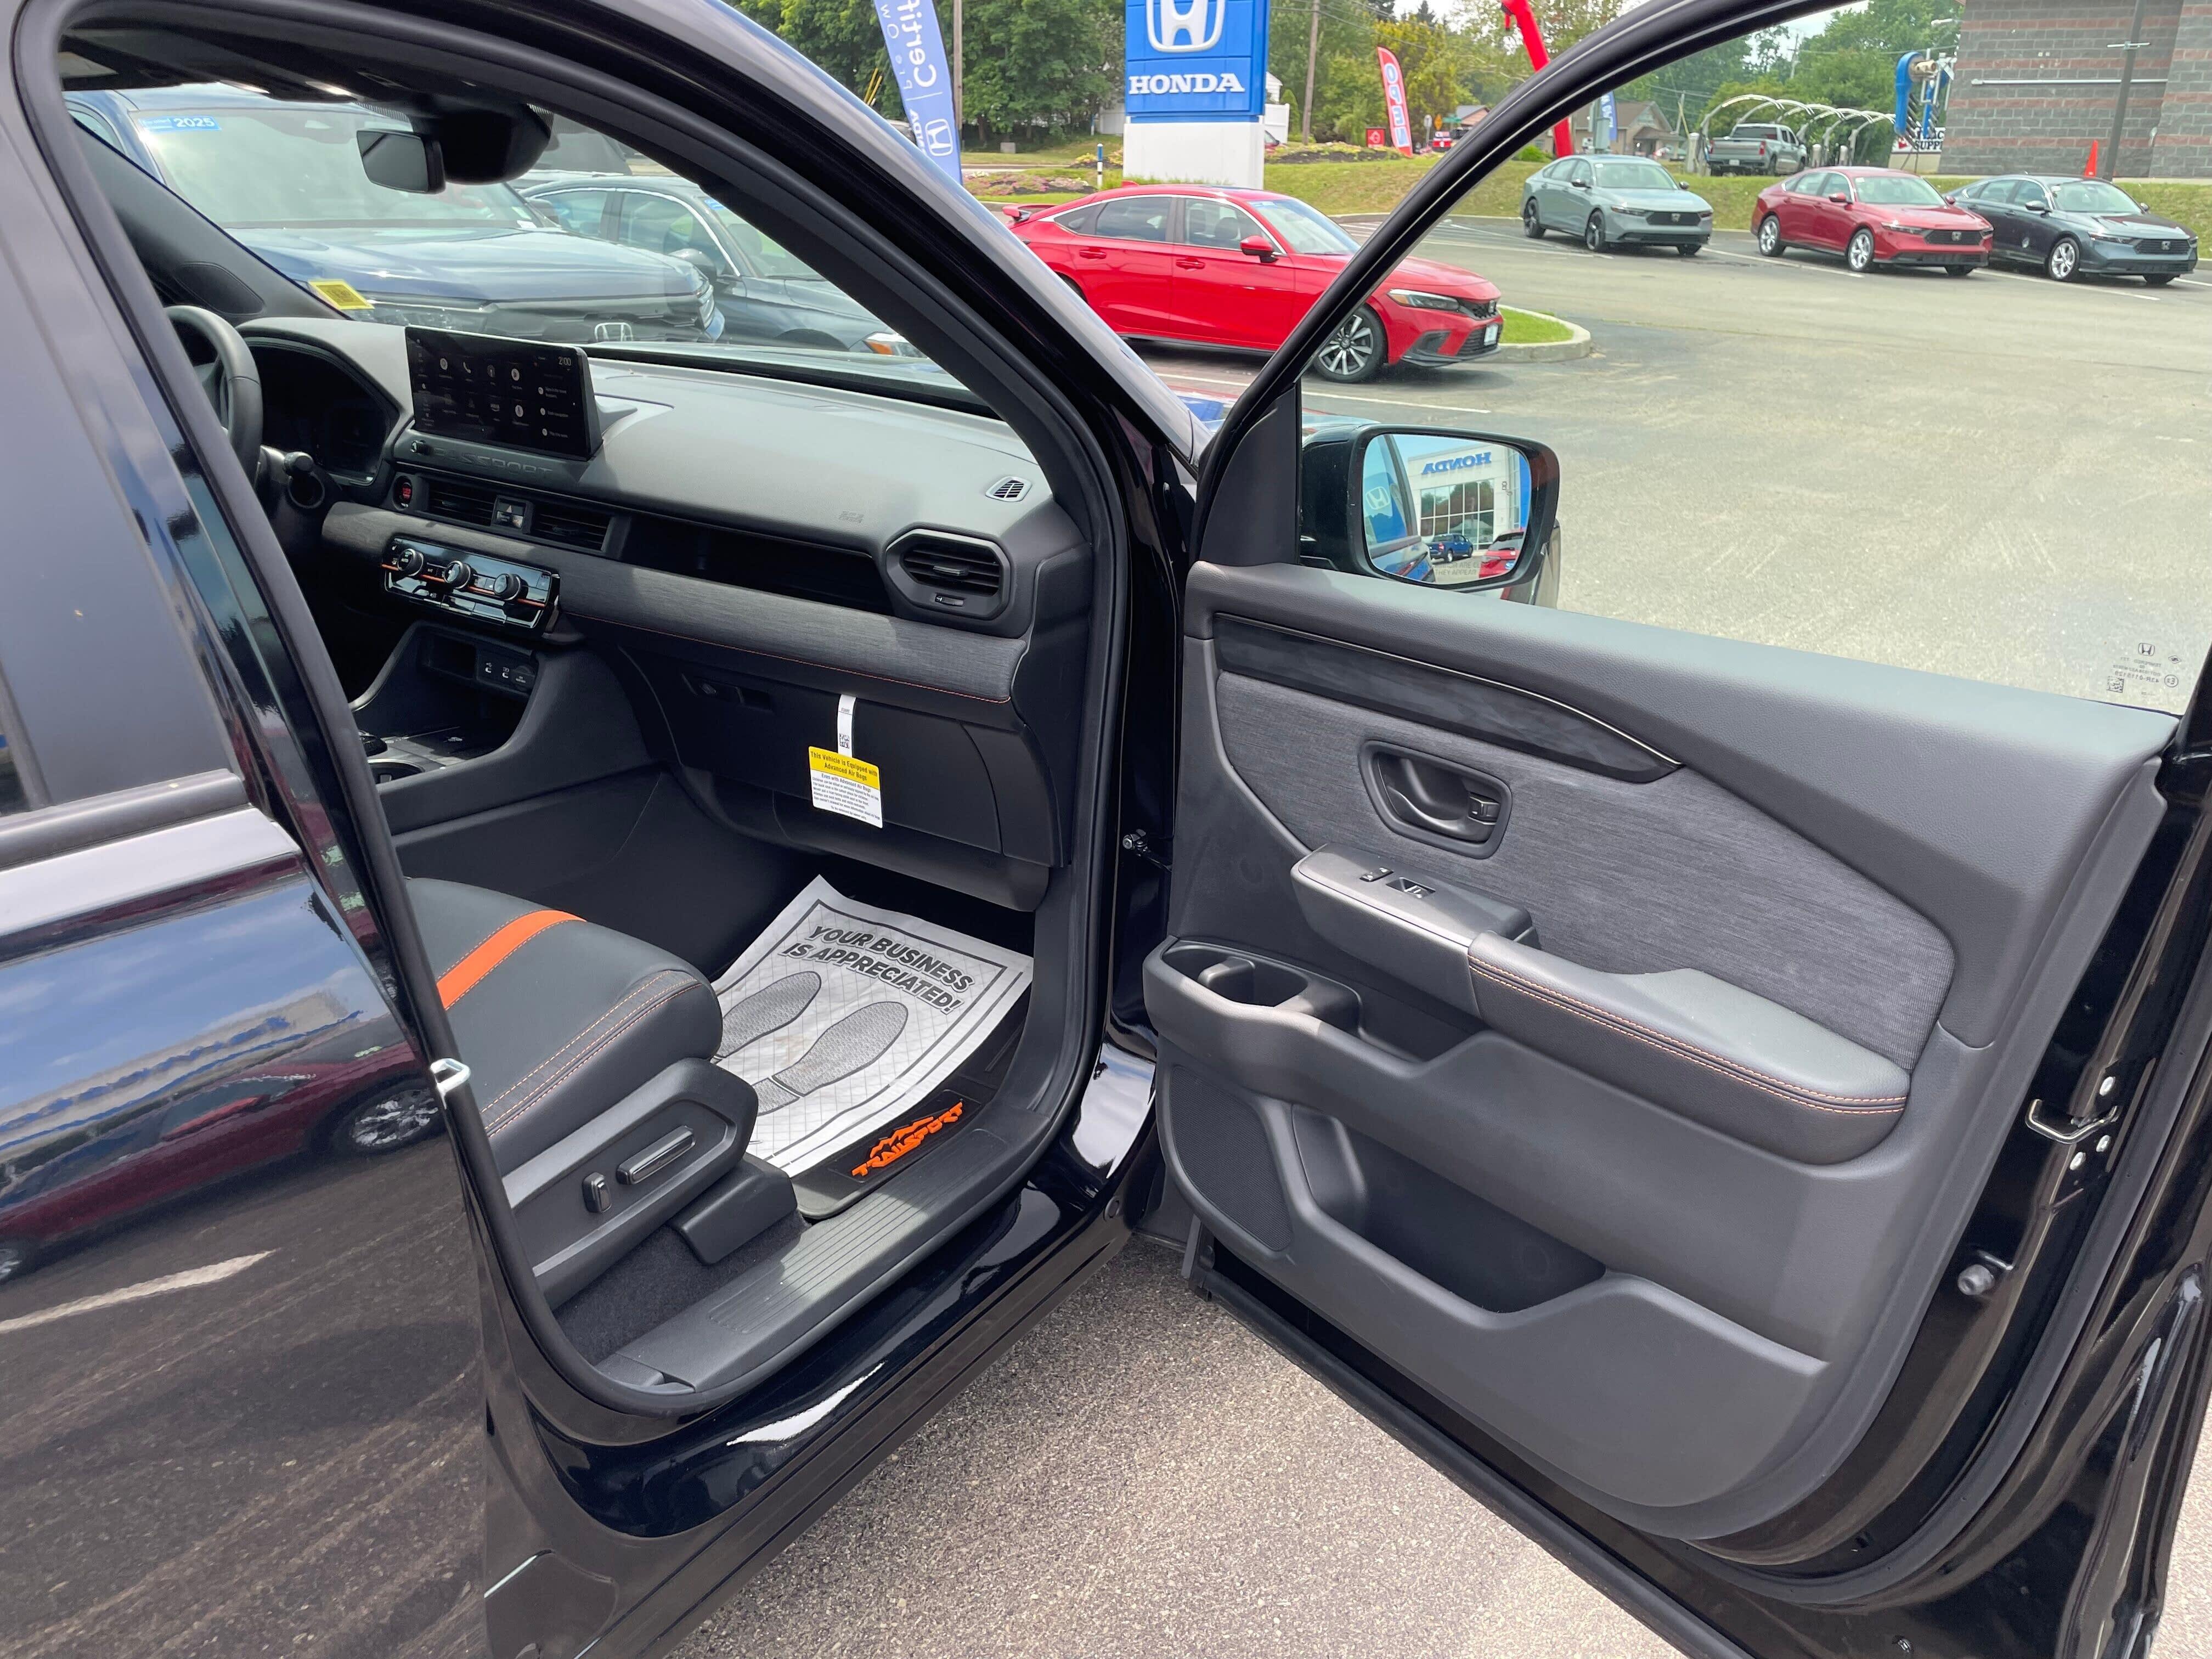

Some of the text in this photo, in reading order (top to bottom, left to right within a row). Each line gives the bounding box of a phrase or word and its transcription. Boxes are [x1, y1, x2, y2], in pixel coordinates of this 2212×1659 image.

[1128, 73, 1246, 94] HONDA
[173, 117, 216, 128] 2025
[1915, 140, 1943, 150] SUPP
[811, 751, 821, 759] This
[822, 754, 840, 764] Vehicle
[847, 760, 868, 772] Equipped
[868, 769, 878, 777] with
[824, 762, 848, 774] Advanced
[856, 772, 867, 781] Bags
[807, 926, 974, 991] YOUR BUSINESS
[780, 942, 963, 1013] IS APPRECIATED!
[851, 1102, 963, 1177] TRAILSPORT
